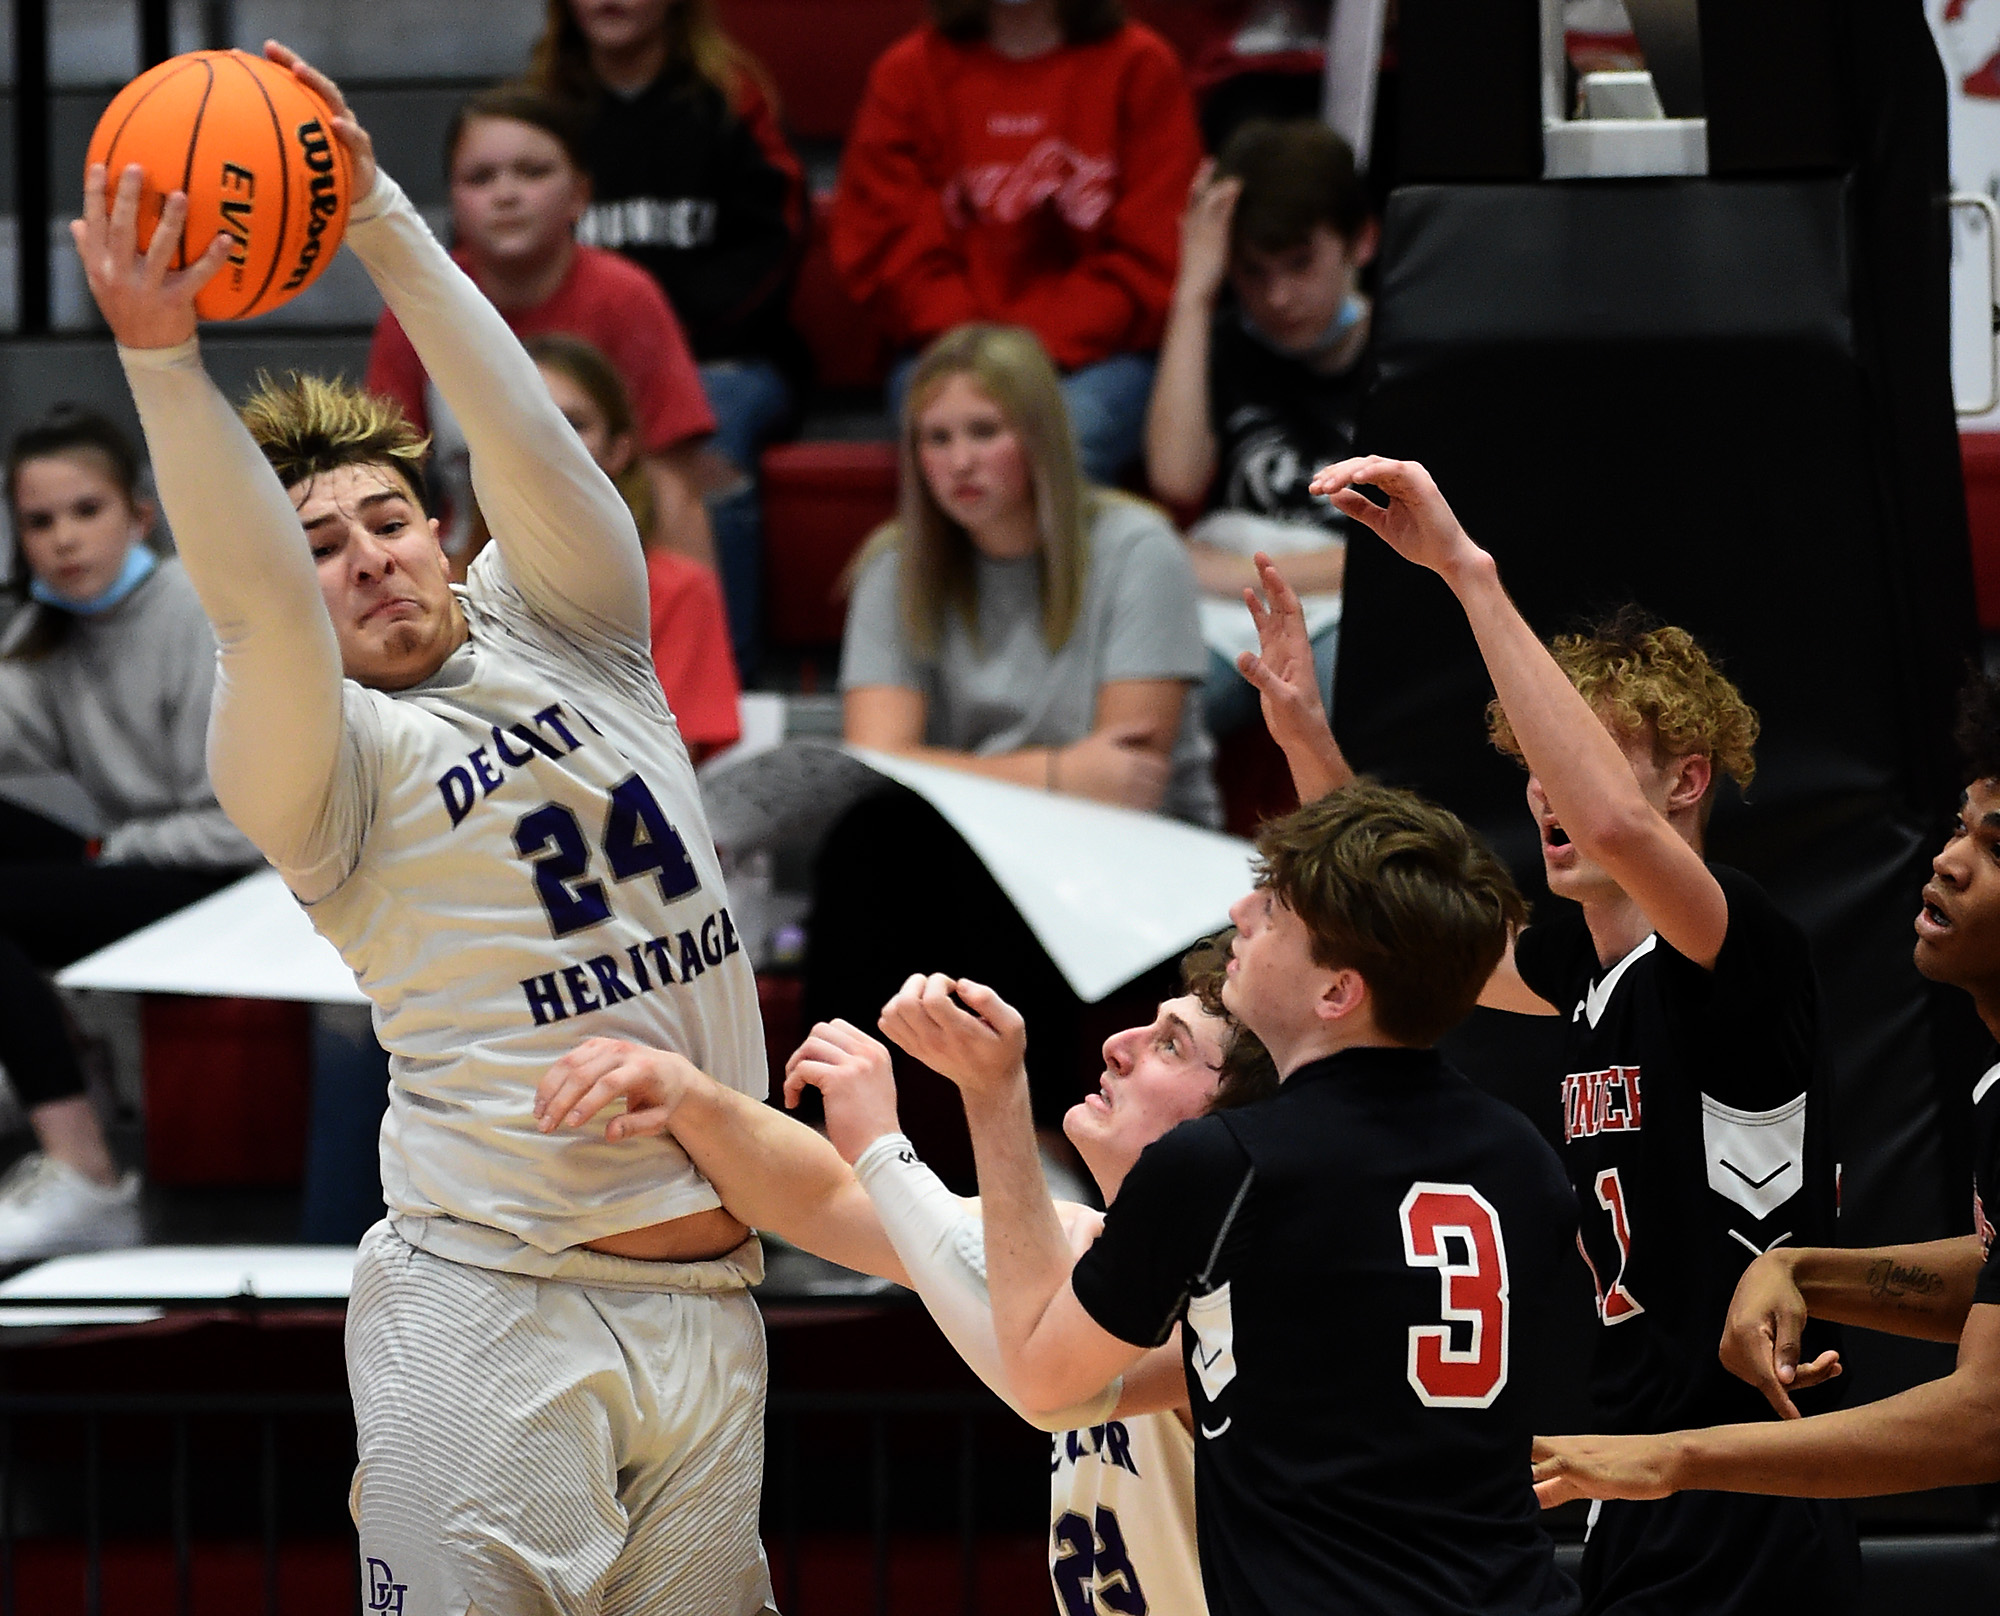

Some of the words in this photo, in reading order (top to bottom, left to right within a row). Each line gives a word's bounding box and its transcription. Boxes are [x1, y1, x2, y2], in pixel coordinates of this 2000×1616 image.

[281, 116, 338, 290] Wilson
[437, 699, 606, 831] DECAT
[511, 771, 702, 940] 24
[519, 907, 740, 1027] HERITAGE
[1399, 1181, 1509, 1409] 3
